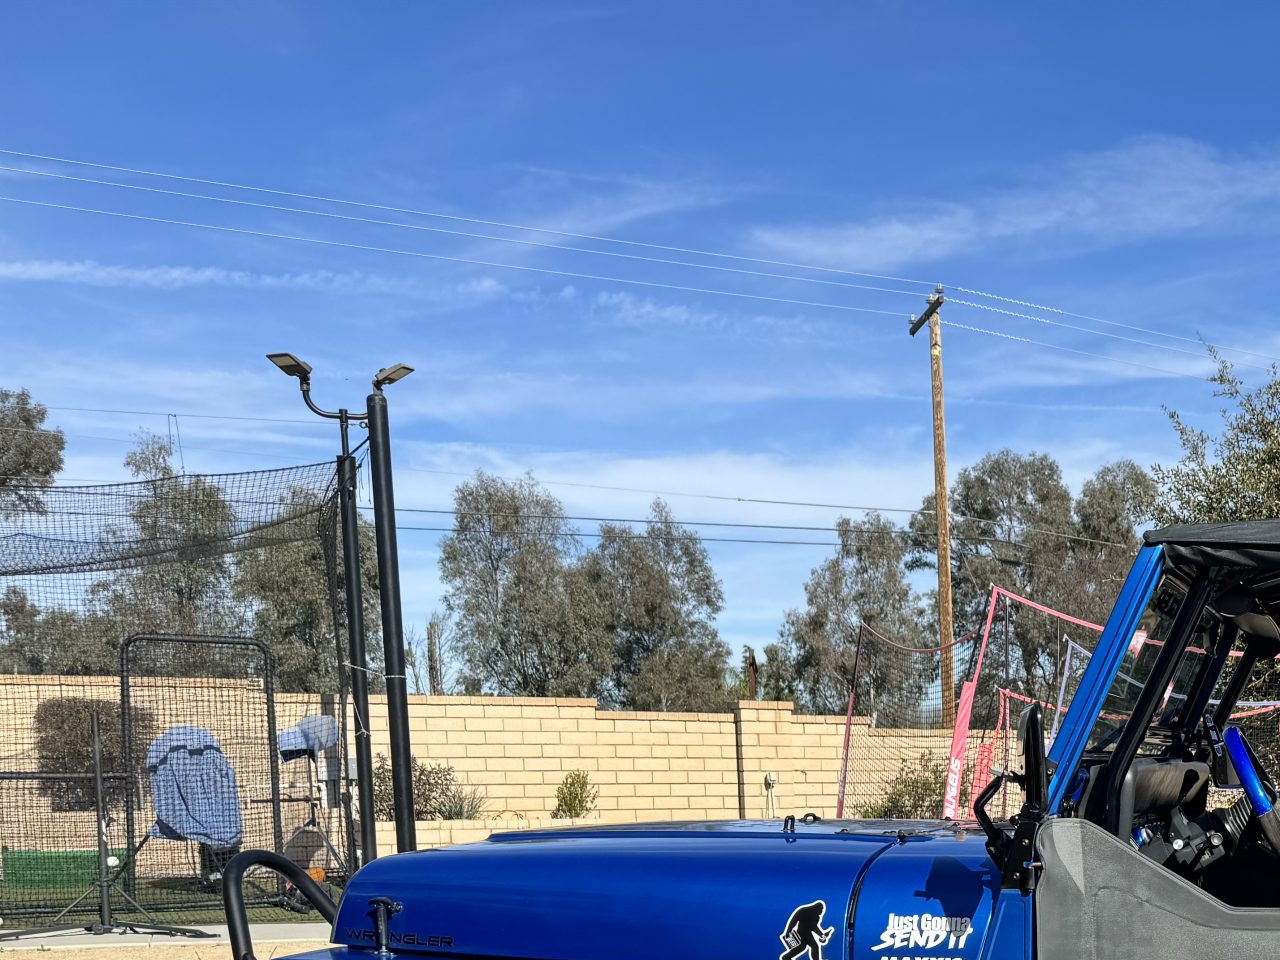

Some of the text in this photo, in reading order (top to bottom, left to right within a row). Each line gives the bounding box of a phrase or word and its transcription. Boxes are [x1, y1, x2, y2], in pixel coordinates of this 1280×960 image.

[887, 913, 970, 932] Just Gonna
[346, 927, 455, 947] WRNGLER
[871, 929, 947, 951] SEND
